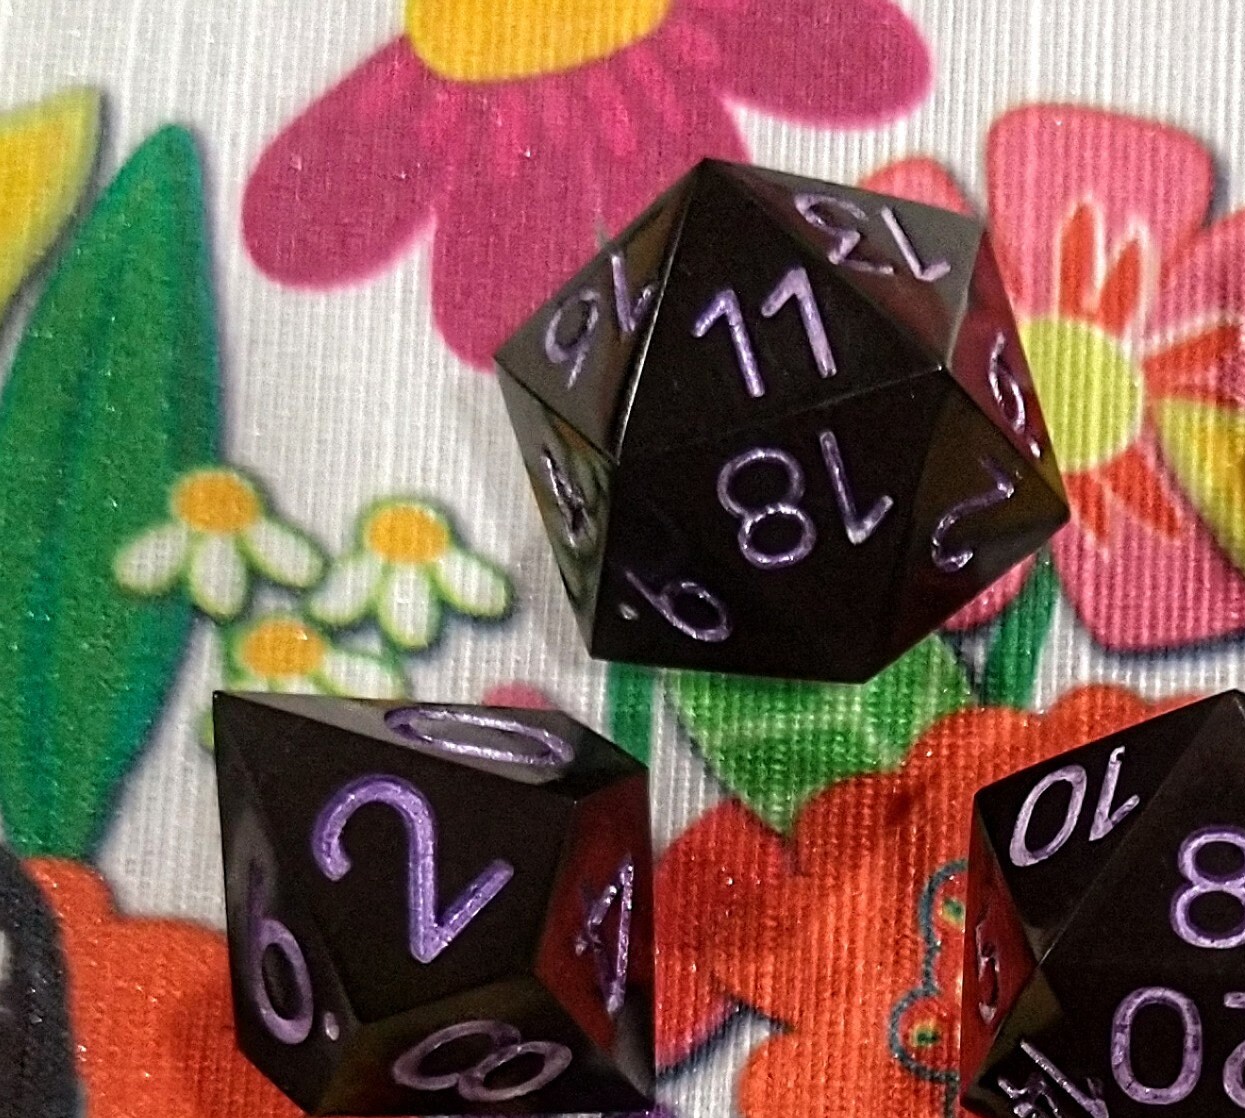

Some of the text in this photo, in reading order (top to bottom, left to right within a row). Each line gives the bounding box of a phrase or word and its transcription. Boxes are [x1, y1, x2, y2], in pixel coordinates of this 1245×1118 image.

[691, 267, 837, 397] 11
[718, 430, 893, 568] 18
[931, 457, 1015, 572] 2
[385, 707, 575, 766] 0
[1009, 746, 1139, 866] 10
[312, 773, 513, 963] 2
[393, 1019, 572, 1101] 8
